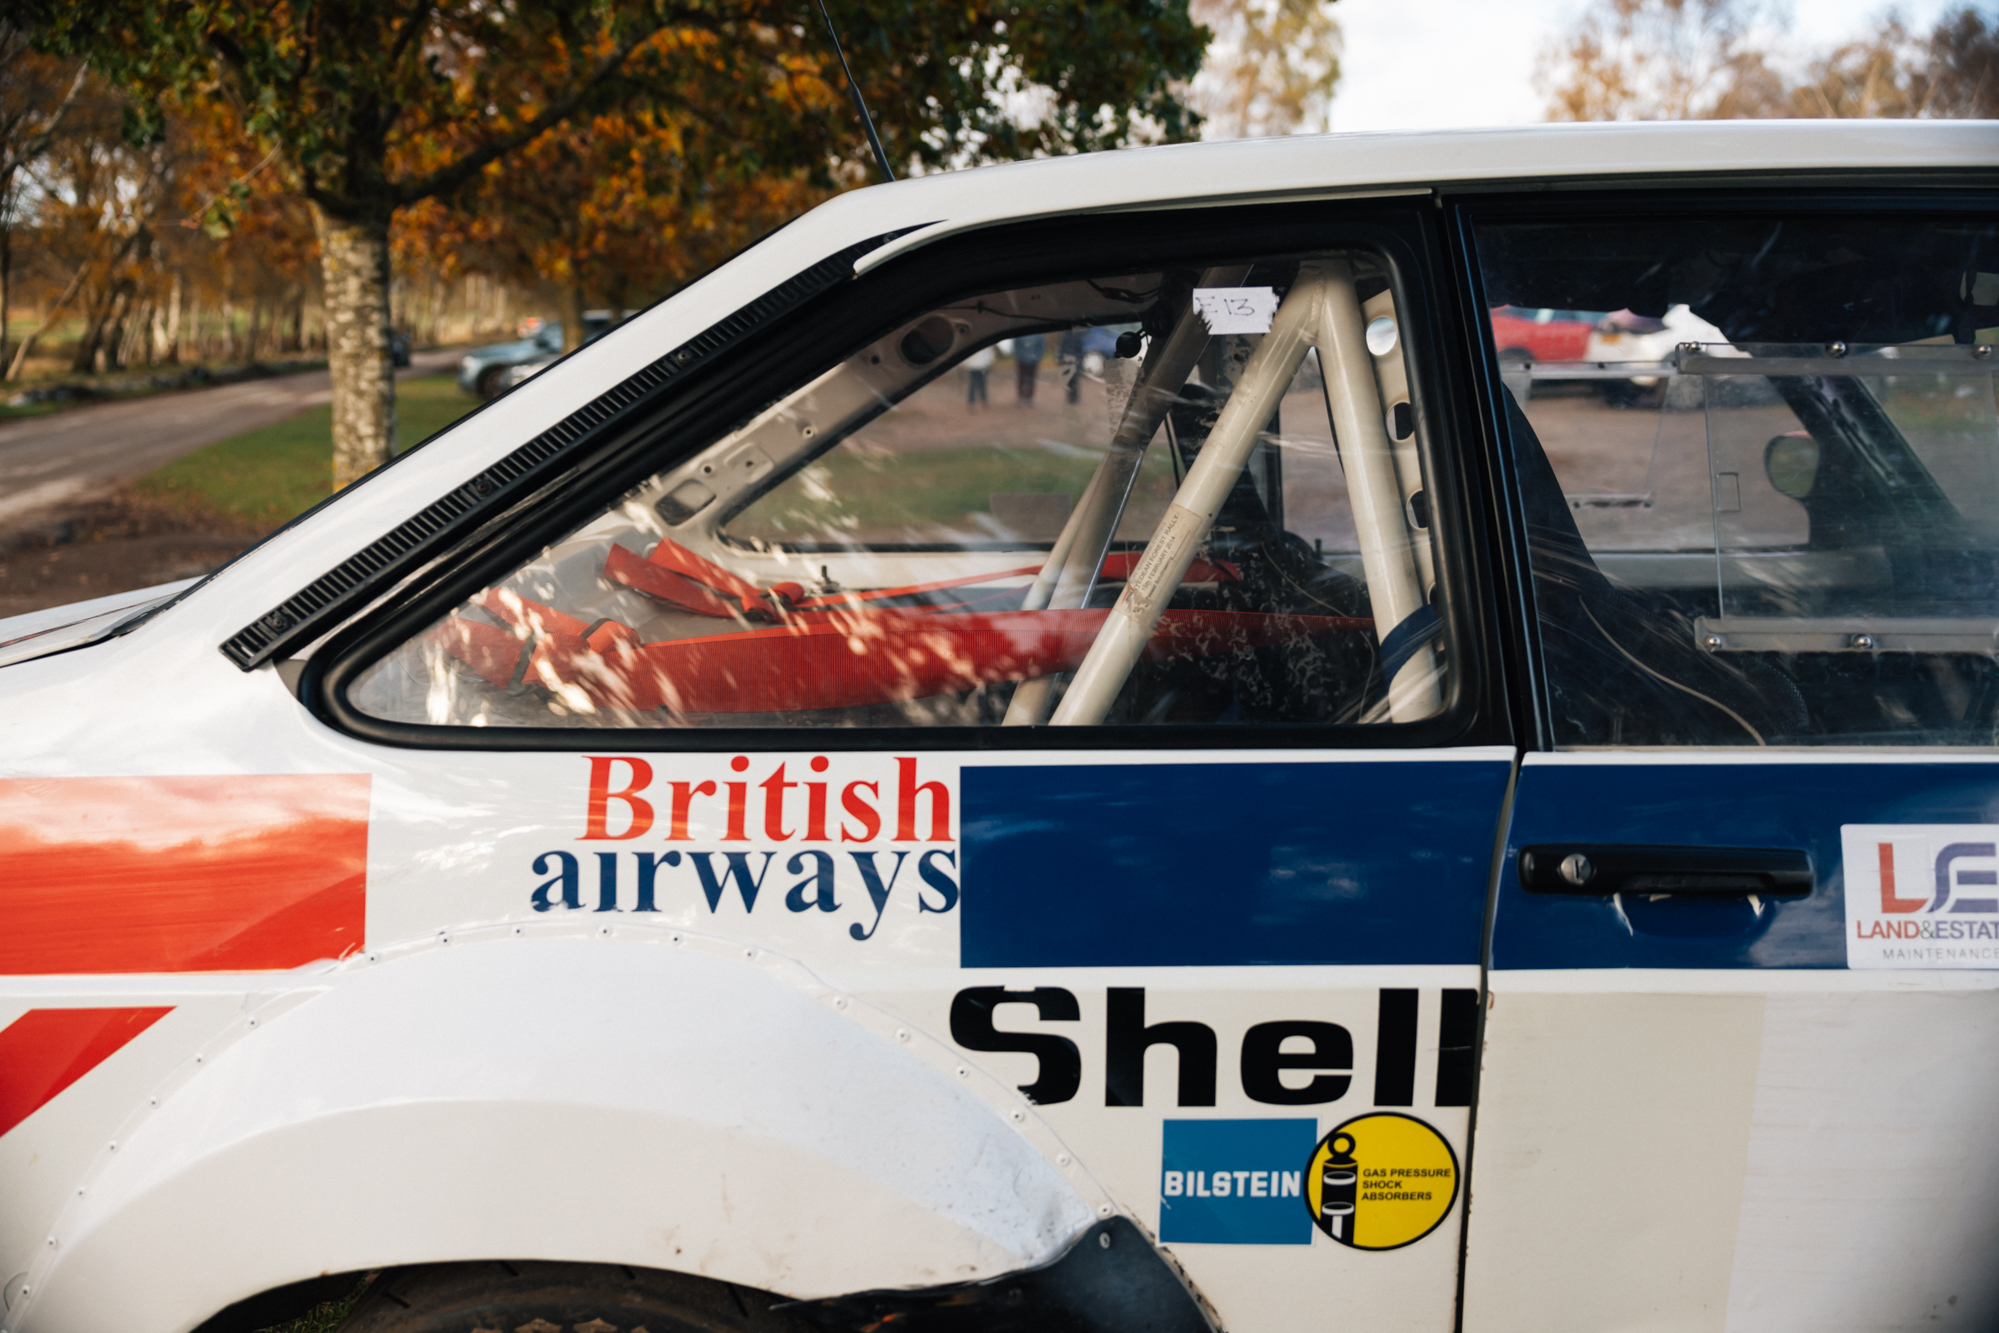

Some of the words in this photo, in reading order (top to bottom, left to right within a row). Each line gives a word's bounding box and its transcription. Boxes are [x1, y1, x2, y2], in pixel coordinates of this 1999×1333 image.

[1147, 548, 1168, 580] FEBRUARY
[1165, 535, 1176, 549] 2014
[1150, 536, 1167, 560] FOREST
[1166, 514, 1179, 535] RALLY
[574, 755, 956, 843] British
[530, 850, 960, 941] airways
[949, 984, 1478, 1107] Shell
[1164, 1170, 1301, 1198] BILSTEIN
[1362, 1180, 1402, 1189] SHOCK
[1363, 1168, 1387, 1178] GAS
[1390, 1168, 1451, 1178] PRESSURE
[1361, 1191, 1432, 1201] ABSORBERS
